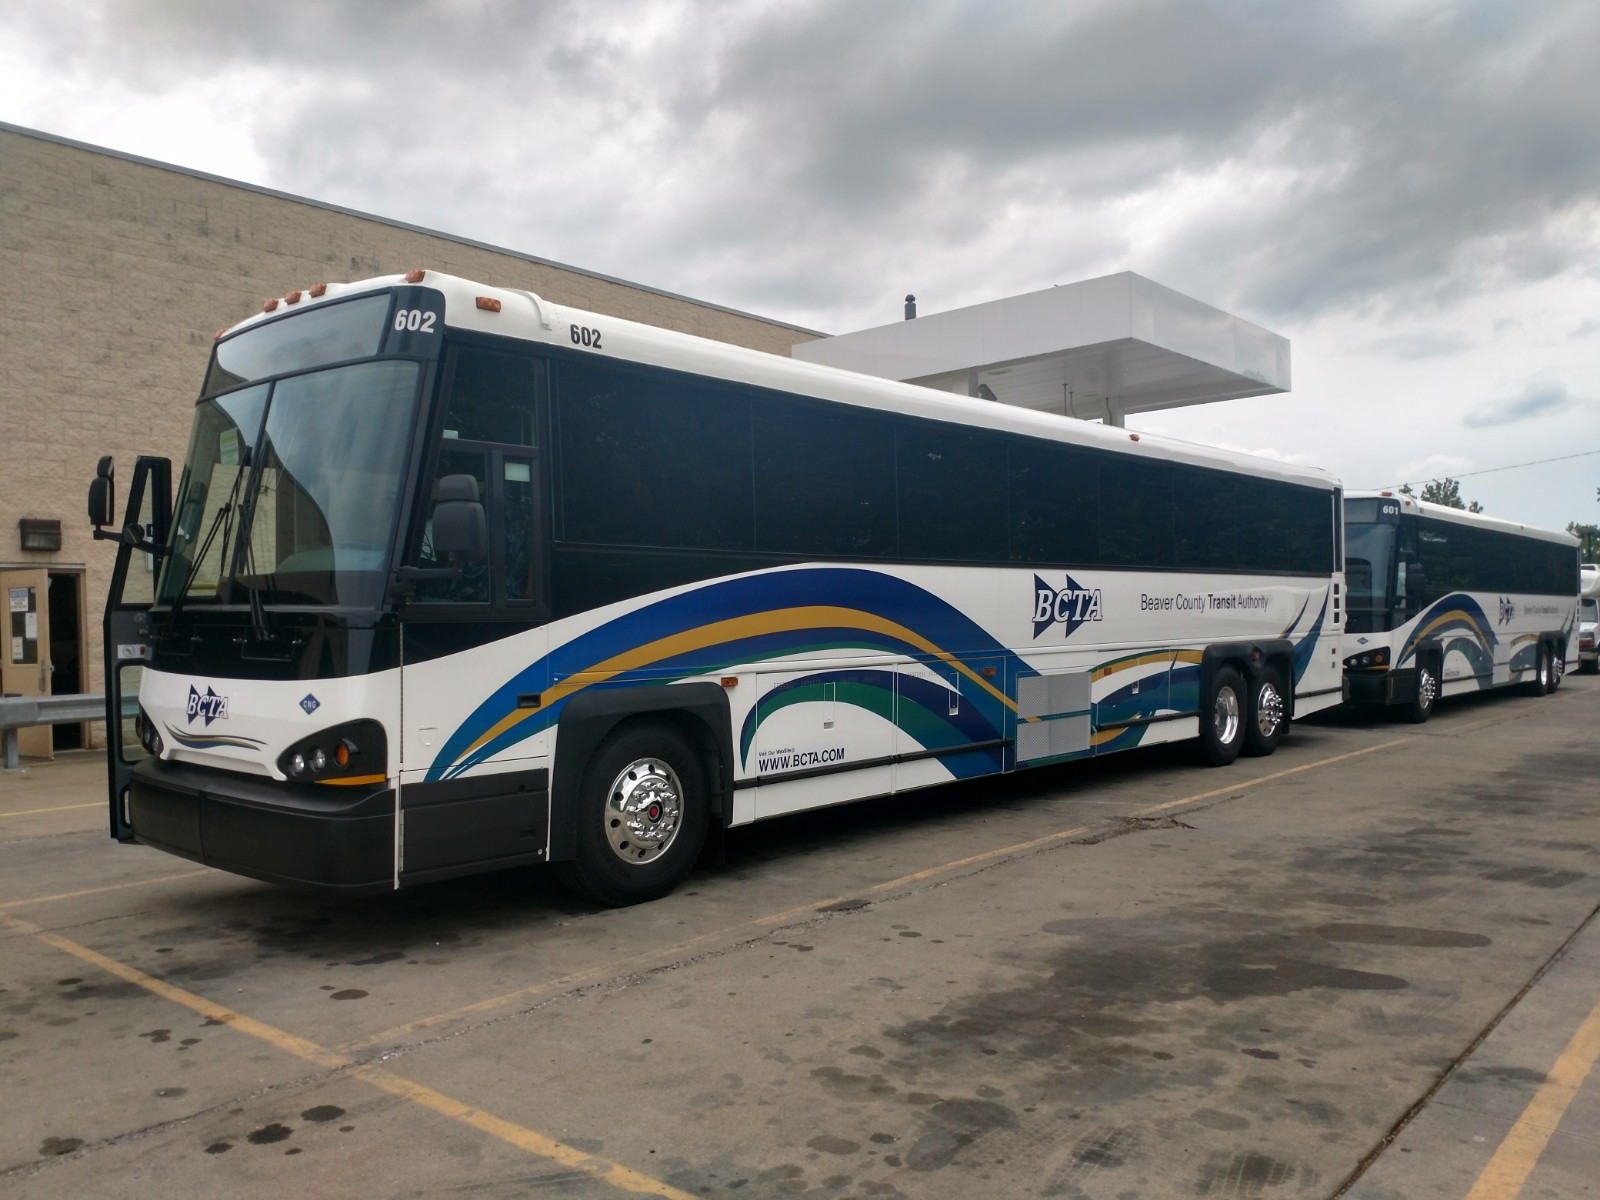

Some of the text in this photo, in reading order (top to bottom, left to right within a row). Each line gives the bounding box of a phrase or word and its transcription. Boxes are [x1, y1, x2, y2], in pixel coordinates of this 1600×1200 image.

[395, 310, 436, 333] 602
[570, 324, 602, 349] 602
[1383, 506, 1398, 514] 601
[1032, 588, 1103, 622] BCTA
[1141, 594, 1269, 613] Beaver County Transit Authority
[187, 693, 229, 719] BCTA
[303, 700, 316, 708] CNG
[759, 748, 845, 772] WWW.BCTA.COM
